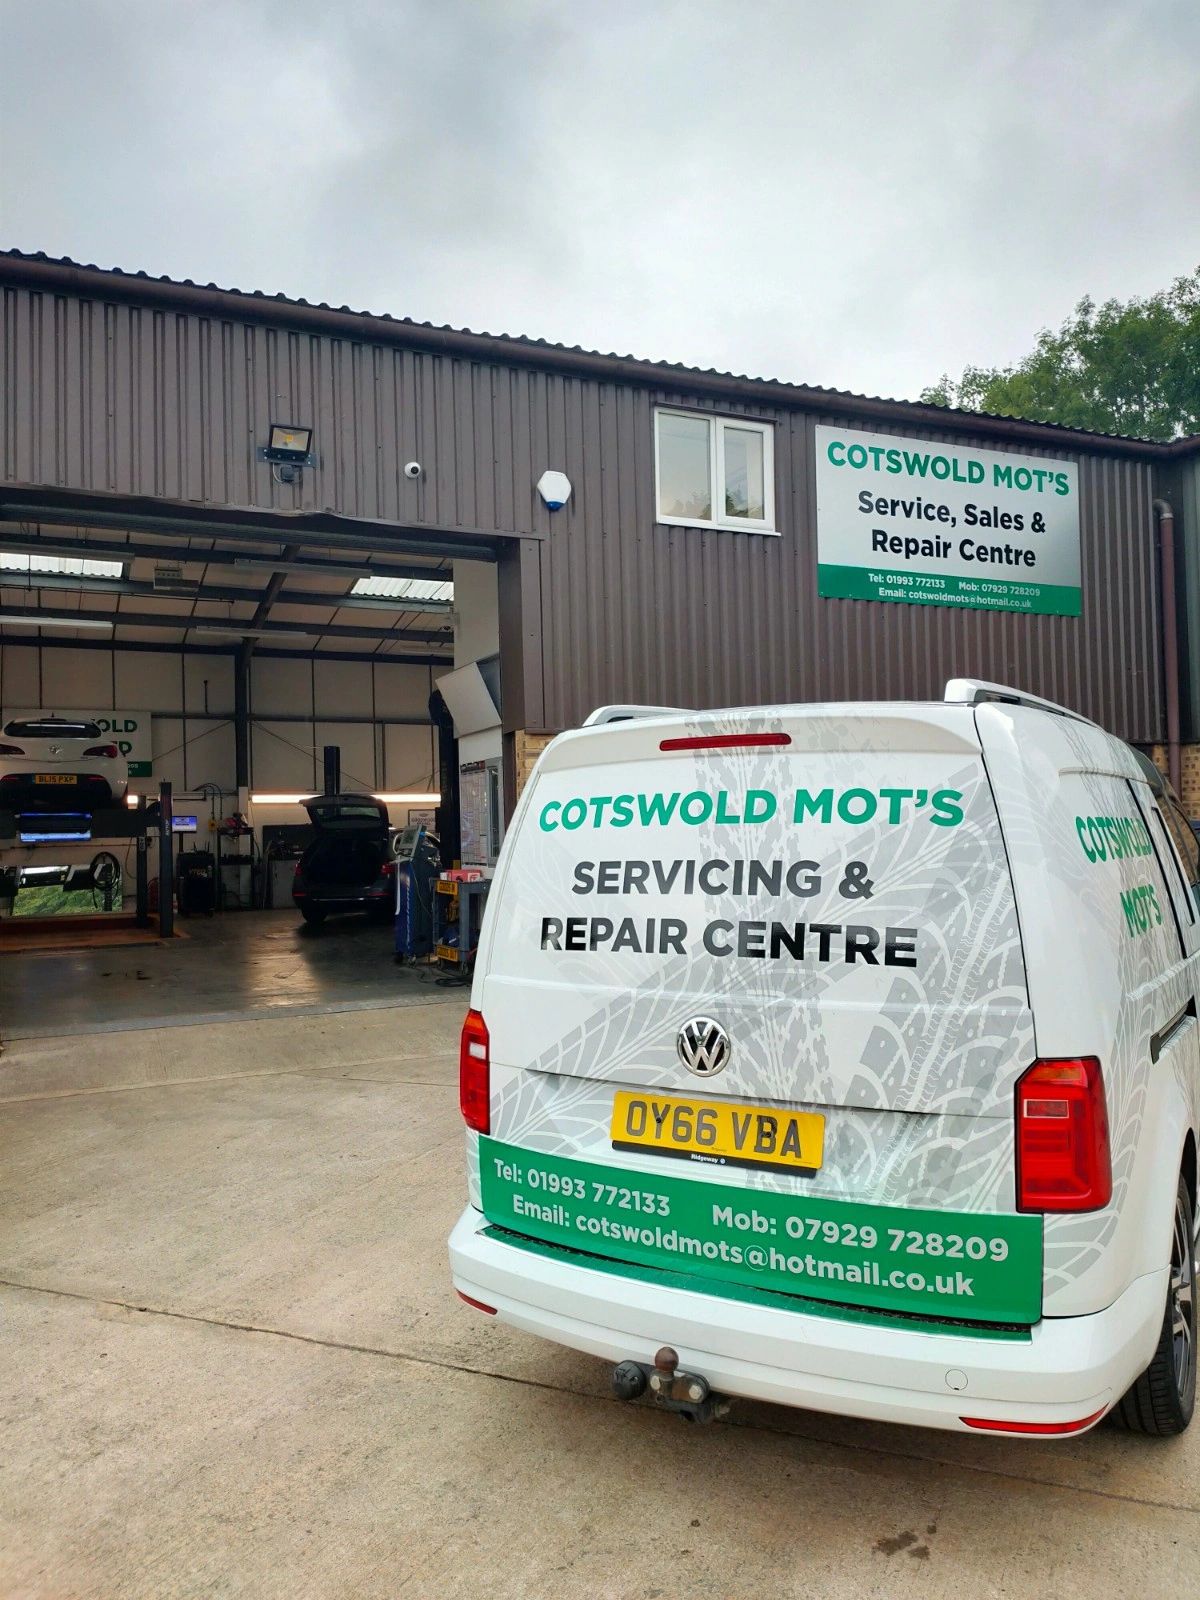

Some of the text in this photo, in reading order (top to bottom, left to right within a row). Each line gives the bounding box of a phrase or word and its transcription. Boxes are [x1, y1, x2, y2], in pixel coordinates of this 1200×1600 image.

[827, 441, 1070, 496] COTSWOLD MOT'S
[857, 490, 1046, 533] Service, Sales &
[871, 529, 1036, 568] Repair Centre
[868, 573, 1041, 597] Tel: 01993 772133 Mob: 07929 728209
[878, 587, 1032, 609] Email: cotswoldmots@hotmail.co.uk
[539, 787, 965, 833] COTSWOLD MOT'S
[1075, 815, 1153, 864] COTSWOLD
[571, 859, 875, 900] SERVICING &
[540, 917, 919, 968] REPAIR CENTRE
[625, 1100, 802, 1159] OY66 VBA
[690, 1152, 719, 1164] Ridgeway
[493, 1158, 1009, 1262] Tel: 01993 772133 Mob: 07929 728209
[512, 1194, 975, 1297] Email: cotswoldmots@hotmail.co.uk
